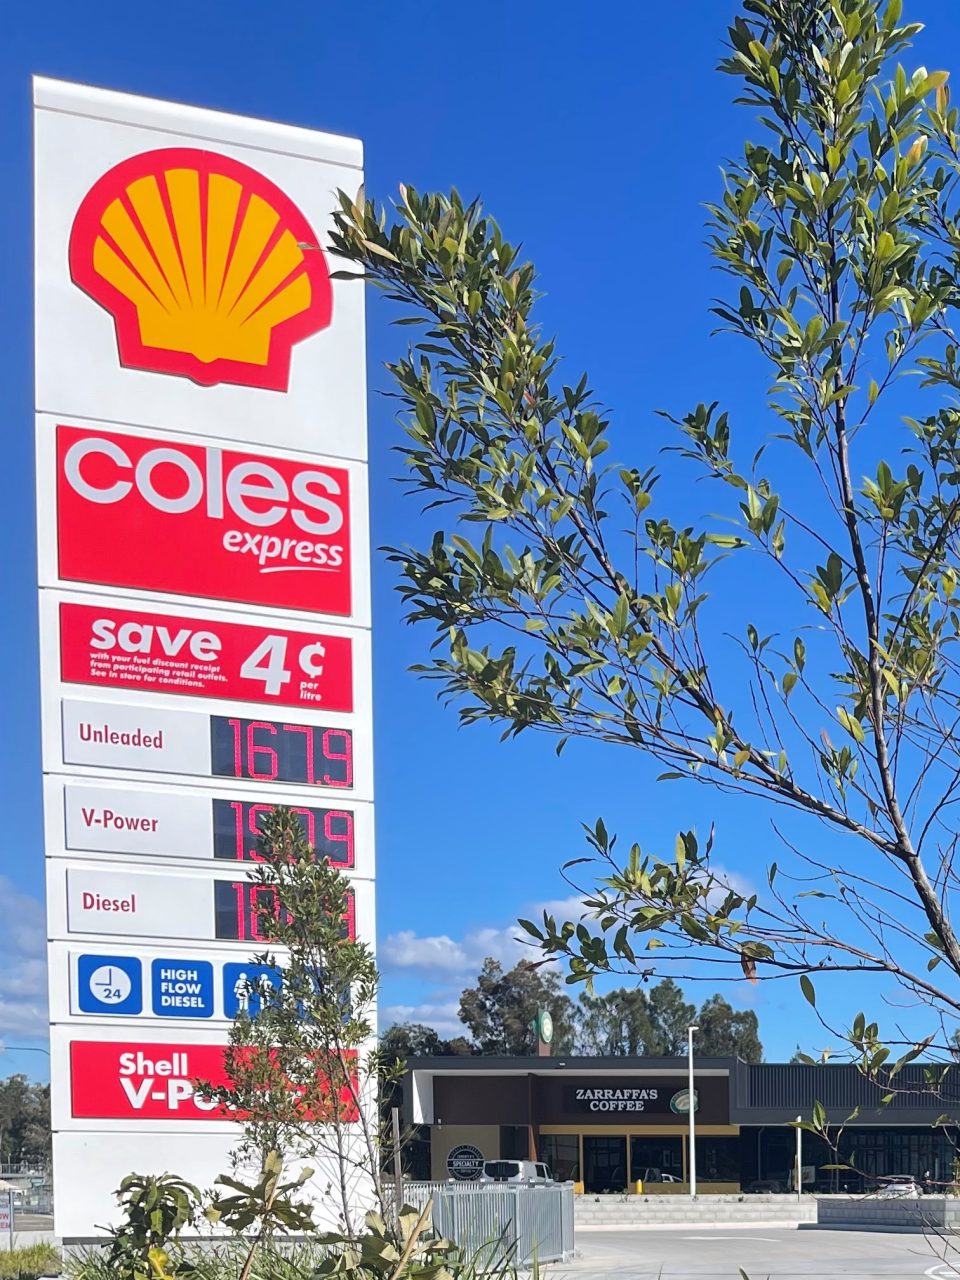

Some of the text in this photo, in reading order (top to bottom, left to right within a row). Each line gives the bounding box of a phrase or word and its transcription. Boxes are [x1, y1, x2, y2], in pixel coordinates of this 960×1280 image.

[64, 437, 343, 535] coles
[222, 530, 343, 566] express
[90, 619, 222, 661] save
[90, 652, 220, 673] with your fuel discount receipt
[90, 660, 111, 669] from
[113, 663, 170, 677] participating
[172, 670, 195, 678] retail
[90, 668, 106, 677] See
[120, 672, 141, 681] store
[159, 677, 205, 688] conditions.
[300, 681, 319, 690] per
[300, 690, 322, 701] litre
[79, 723, 163, 749] Unleaded
[82, 808, 158, 832] V-Power
[83, 892, 136, 913] Diesel
[160, 969, 197, 981] HIGH
[103, 988, 121, 999] 24
[161, 982, 201, 994] FLOW
[161, 996, 205, 1008] DIESEL
[119, 1052, 187, 1077] Shell
[576, 1089, 658, 1100] ZARRAFFA'S
[590, 1101, 644, 1111] COFFEE
